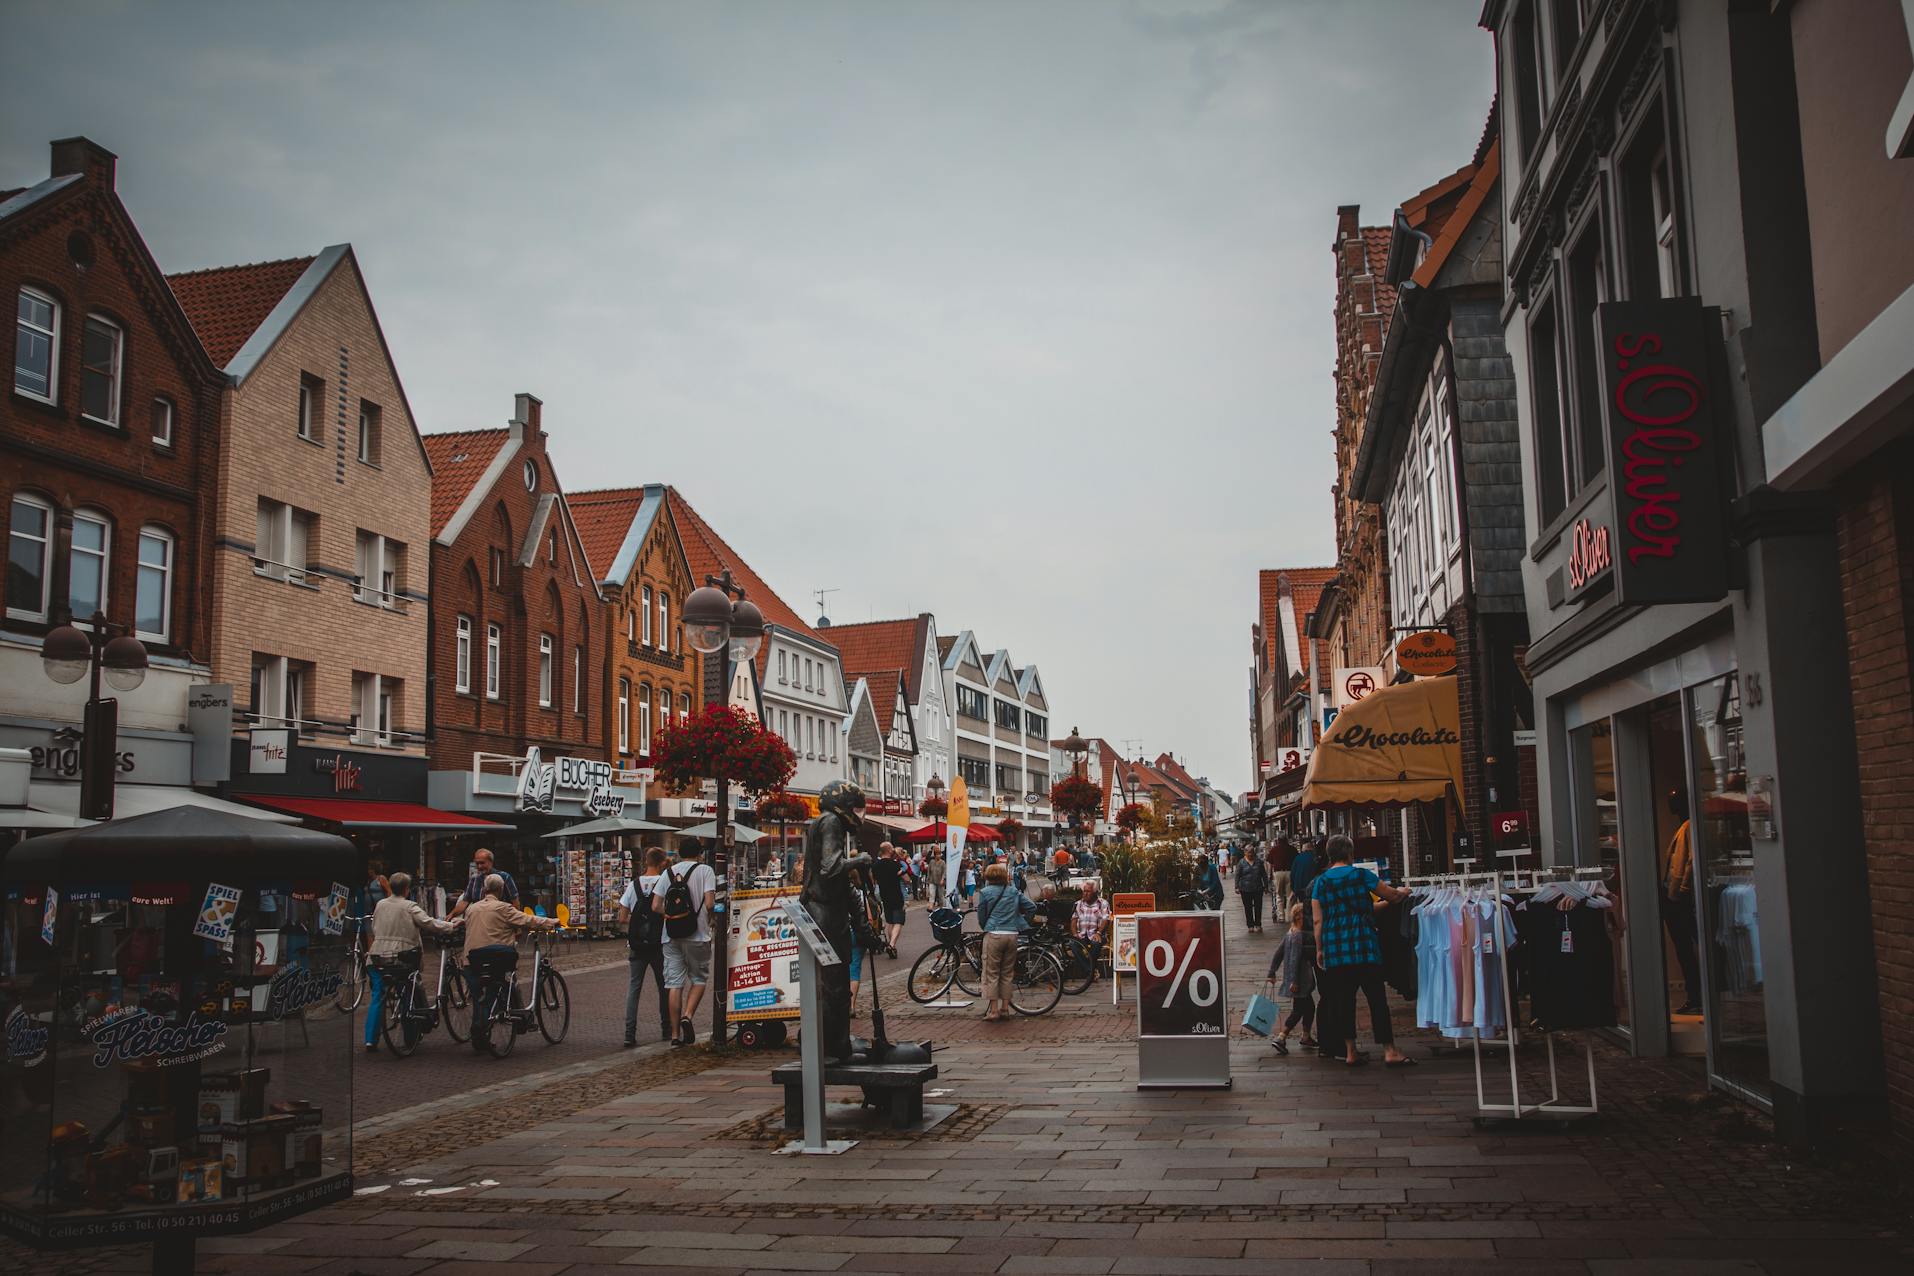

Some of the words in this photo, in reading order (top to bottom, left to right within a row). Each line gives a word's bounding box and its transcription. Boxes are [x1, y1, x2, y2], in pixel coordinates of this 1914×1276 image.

[1615, 332, 1703, 567] s.Oliver
[1570, 519, 1612, 590] s.Oliver
[189, 698, 228, 710] engbers
[1334, 724, 1459, 750] Chocolata
[31, 744, 135, 776] engrs
[590, 786, 625, 814] Leseberg
[209, 885, 238, 901] SPIEL
[333, 884, 348, 897] SPIEL
[196, 922, 227, 938] SPASS
[326, 919, 341, 933] SPASS
[1144, 937, 1219, 1009] %
[1191, 1021, 1221, 1034] s.Oliver
[156, 1041, 226, 1068] SCHREIBWAREN
[87, 1224, 109, 1236] Str.
[111, 1222, 126, 1232] 56
[135, 1219, 153, 1231] Tel.
[209, 1213, 223, 1224] 40
[225, 1211, 240, 1223] 45
